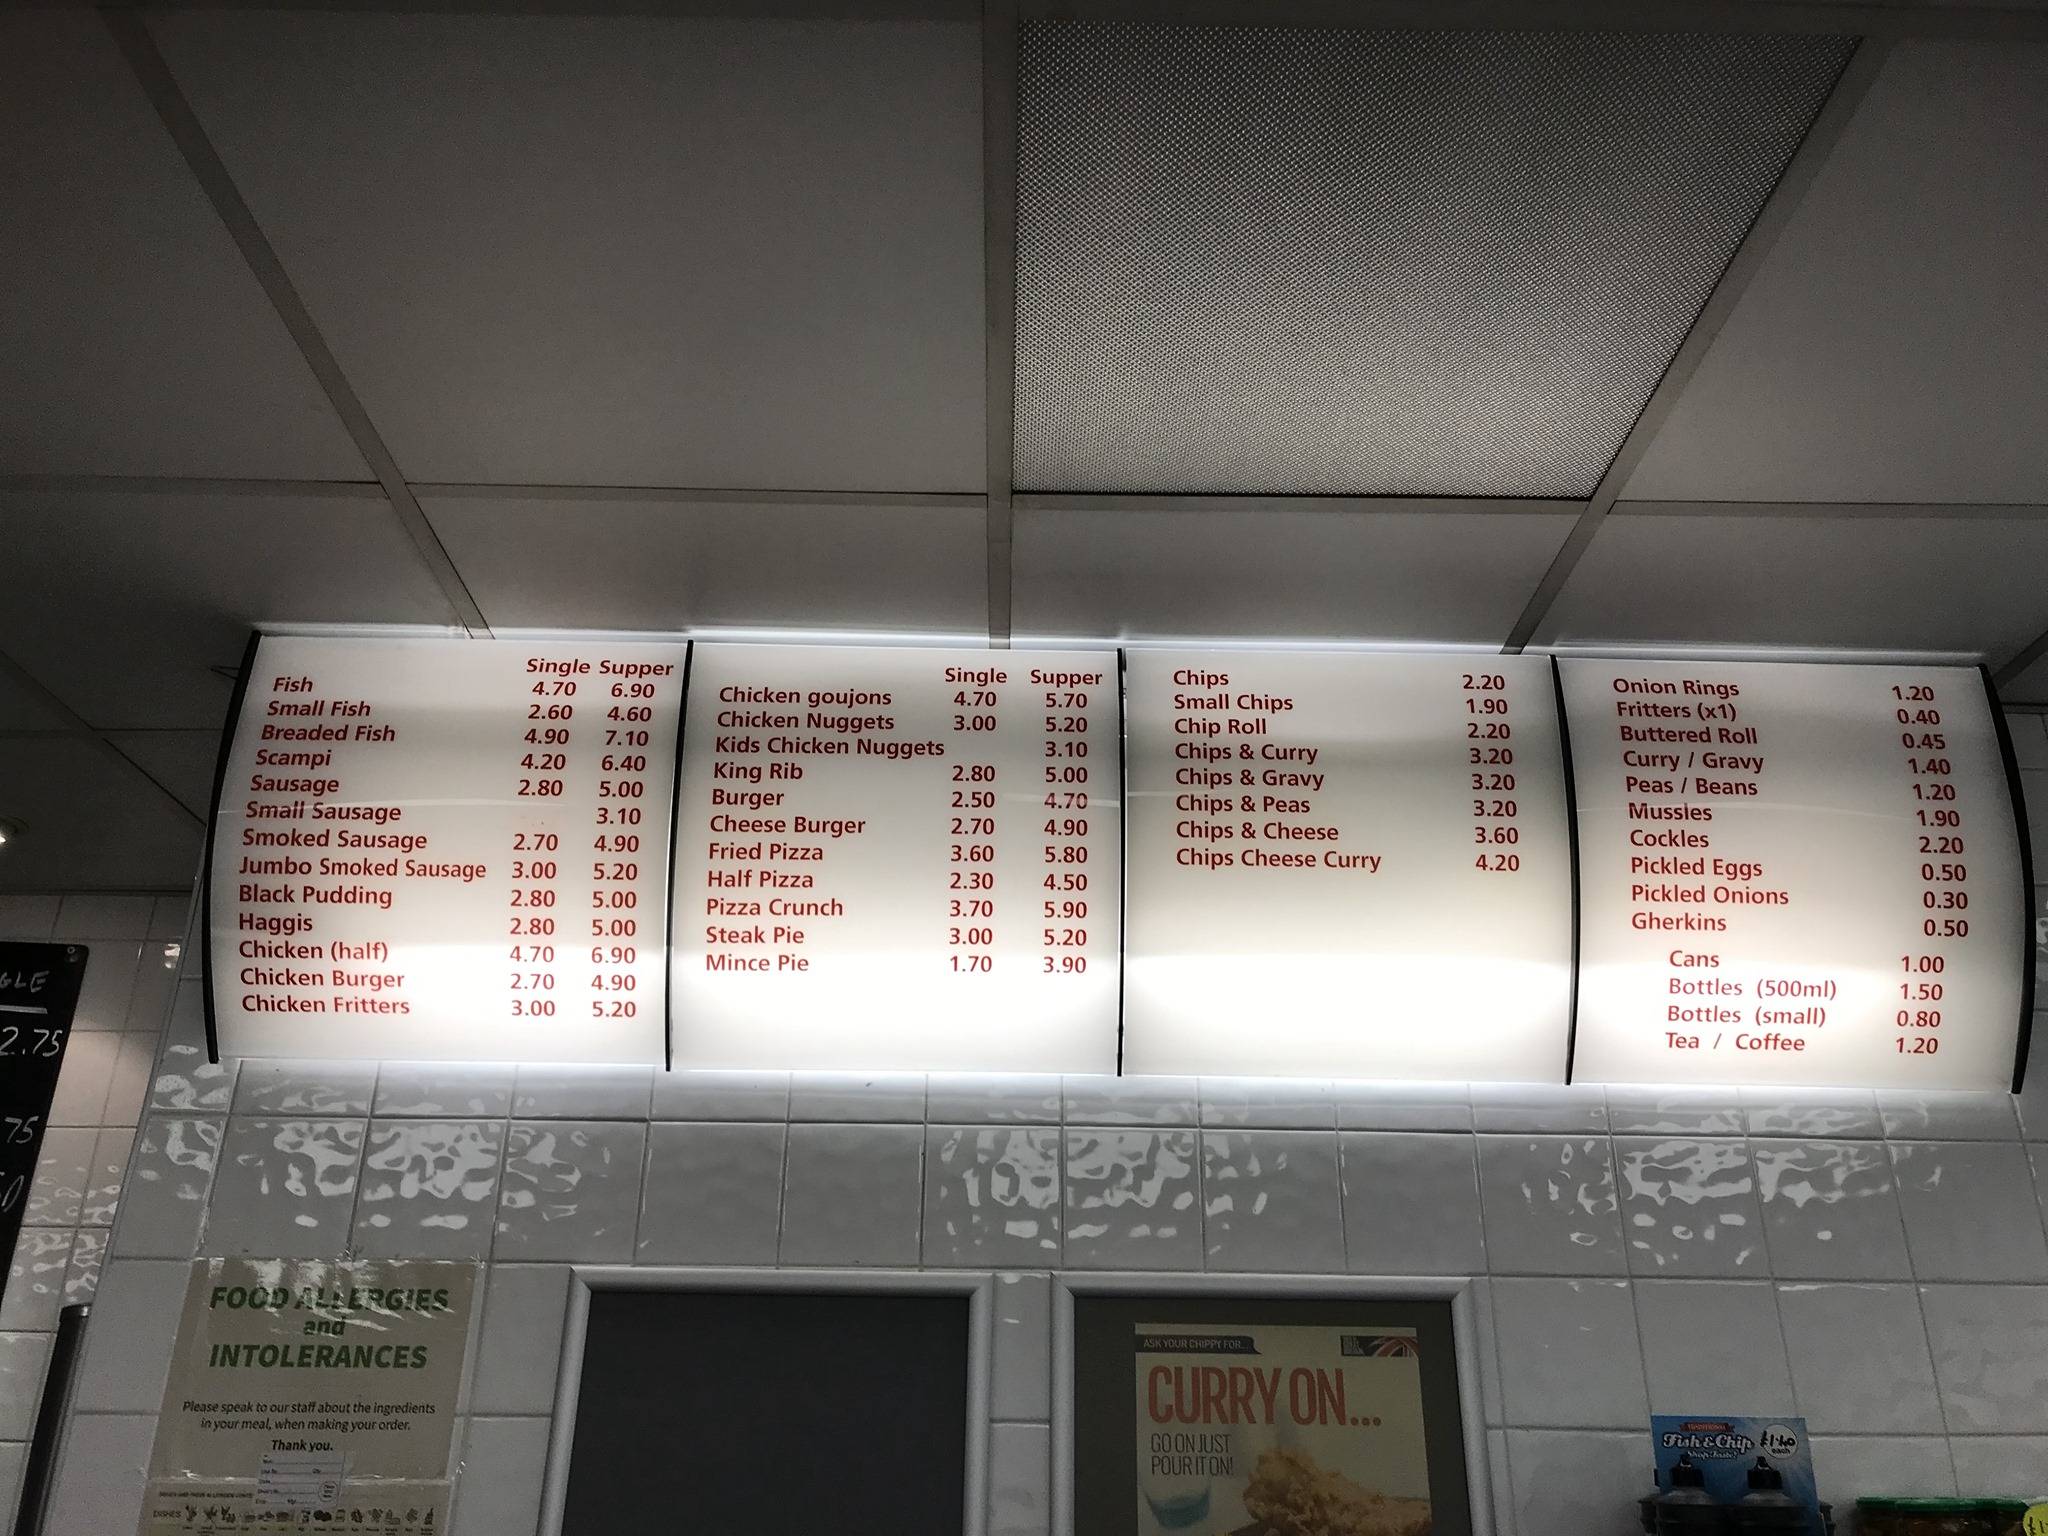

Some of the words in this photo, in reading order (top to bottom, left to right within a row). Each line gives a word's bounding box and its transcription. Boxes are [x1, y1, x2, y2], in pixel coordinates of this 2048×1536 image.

[527, 658, 590, 677] Single
[600, 660, 674, 679] Supper
[945, 667, 1007, 687] Single
[1031, 670, 1102, 688] Supper
[274, 677, 313, 692] Fish
[611, 683, 655, 698] 6.90
[1174, 670, 1229, 689] Chips
[1614, 679, 1676, 694] Onion
[1683, 680, 1739, 699] Rings
[720, 686, 800, 703] Chicken
[808, 689, 891, 708] goujons
[1046, 693, 1087, 708] 5.70
[1174, 694, 1229, 709] Small
[1237, 694, 1293, 714] Chips
[268, 701, 324, 716] Small
[331, 701, 370, 716] Fish
[1617, 702, 1690, 717] Fritters
[1698, 703, 1736, 721] (x1)
[1898, 709, 1939, 724] 0.40
[718, 711, 798, 728] Chicken
[807, 713, 894, 733] Nuggets
[1175, 718, 1220, 738] Chip
[1228, 718, 1266, 734] Roll
[1468, 723, 1510, 739] 2.20
[262, 725, 348, 741] Breaded
[355, 725, 395, 741] Fish
[606, 730, 648, 746] 7.10
[1621, 726, 1711, 742] Buttered
[1718, 728, 1757, 744] Roll
[716, 736, 760, 753] Kids
[768, 737, 848, 754] Chicken
[857, 739, 944, 759] Nuggets
[1175, 743, 1231, 763] Chips
[1262, 744, 1318, 765] Curry
[256, 750, 331, 769] Scampi
[1624, 751, 1679, 771] Curry
[1703, 753, 1763, 774] Gravy
[714, 762, 761, 784] King
[770, 763, 803, 779] Rib
[953, 765, 995, 782] 2.80
[1176, 768, 1232, 789] Chips
[1263, 769, 1324, 791] Gravy
[251, 775, 339, 797] Sausage
[518, 779, 563, 796] 2.80
[1626, 776, 1673, 793] Peas
[1696, 778, 1757, 795] Beans
[712, 789, 784, 810] Burger
[1176, 794, 1233, 816] Chips
[1263, 796, 1310, 813] Peas
[1474, 800, 1516, 817] 3.20
[246, 801, 305, 818] Small
[312, 802, 401, 825] Sausage
[1629, 802, 1712, 821] Mussles
[1917, 810, 1959, 826] 1.90
[710, 814, 786, 833] Cheese
[794, 816, 865, 838] Burger
[952, 817, 994, 835] 2.70
[1176, 820, 1233, 843] Chips
[1264, 822, 1338, 840] Cheese
[243, 828, 330, 847] Smoked
[338, 830, 427, 854] Sausage
[594, 835, 639, 853] 4.90
[1630, 829, 1709, 848] Cockles
[709, 842, 761, 860] Fried
[770, 842, 823, 860] Pizza
[1045, 846, 1088, 863] 5.80
[1176, 848, 1233, 870] Chips
[1241, 848, 1316, 867] Cheese
[1324, 851, 1382, 873] Curry
[240, 856, 312, 875] Jumbo
[320, 857, 398, 876] Smoked
[405, 859, 486, 883] Sausage
[708, 869, 752, 888] Half
[760, 870, 813, 888] Pizza
[1632, 856, 1704, 875] Pickled
[1713, 859, 1762, 881] Eggs
[240, 884, 295, 903] Black
[303, 885, 392, 909] Pudding
[593, 891, 637, 909] 5.00
[1632, 884, 1705, 903] Pickled
[1714, 886, 1789, 905] Onions
[1923, 891, 1968, 909] 0.30
[707, 898, 760, 916] Pizza
[769, 898, 843, 916] Crunch
[1044, 901, 1087, 919] 5.90
[240, 913, 313, 936] Haggis
[1632, 912, 1727, 931] Gherkins
[706, 925, 765, 944] Steak
[774, 926, 804, 944] Pie
[240, 940, 323, 959] Chicken
[331, 941, 388, 962] (half)
[510, 945, 554, 962] 4.70
[1669, 950, 1719, 967] Cans
[706, 954, 770, 971] Mince
[779, 954, 808, 971] Pie
[950, 955, 992, 972] 1.70
[241, 967, 324, 986] Chicken
[333, 970, 404, 992] Burger
[1669, 978, 1742, 995] Bottles
[1757, 980, 1836, 999] (500ml)
[242, 994, 325, 1012] Chicken
[334, 996, 410, 1014] Fritters
[512, 1000, 555, 1016] 3.00
[1668, 1005, 1741, 1023] Bottles
[1755, 1007, 1826, 1027] (small)
[1897, 1010, 1941, 1028] 0.80
[0, 1026, 63, 1057] 2.75
[1666, 1032, 1699, 1049] Tea
[1736, 1033, 1805, 1051] Coffee
[209, 1286, 289, 1310] FOOD
[294, 1287, 450, 1311] ALLERGIES
[303, 1316, 346, 1337] and
[1144, 1339, 1161, 1348] ASK
[1163, 1339, 1187, 1348] YOUR
[1189, 1339, 1221, 1349] CHIPPY
[209, 1344, 428, 1369] INTOLERANCES
[1148, 1365, 1281, 1425] CURRY
[1289, 1367, 1382, 1427] ON...
[183, 1401, 219, 1413] Please
[222, 1402, 253, 1415] speak
[256, 1402, 268, 1412] to
[270, 1403, 289, 1412] our
[291, 1401, 316, 1412] staff
[317, 1402, 350, 1413] about
[353, 1402, 371, 1413] the
[374, 1402, 436, 1416] ingredients
[200, 1418, 212, 1428] in
[213, 1419, 239, 1432] your
[241, 1418, 272, 1430] meal,
[275, 1418, 305, 1429] when
[308, 1419, 349, 1432] making
[351, 1420, 377, 1432] your
[379, 1420, 411, 1431] order.
[272, 1439, 307, 1451] Thank
[309, 1441, 333, 1452] you.
[1151, 1433, 1171, 1453] GO
[1175, 1433, 1195, 1453] ON
[1198, 1433, 1232, 1453] JUST
[1152, 1455, 1192, 1475] POUR
[1195, 1455, 1207, 1475] IT
[1209, 1455, 1234, 1476] ON!
